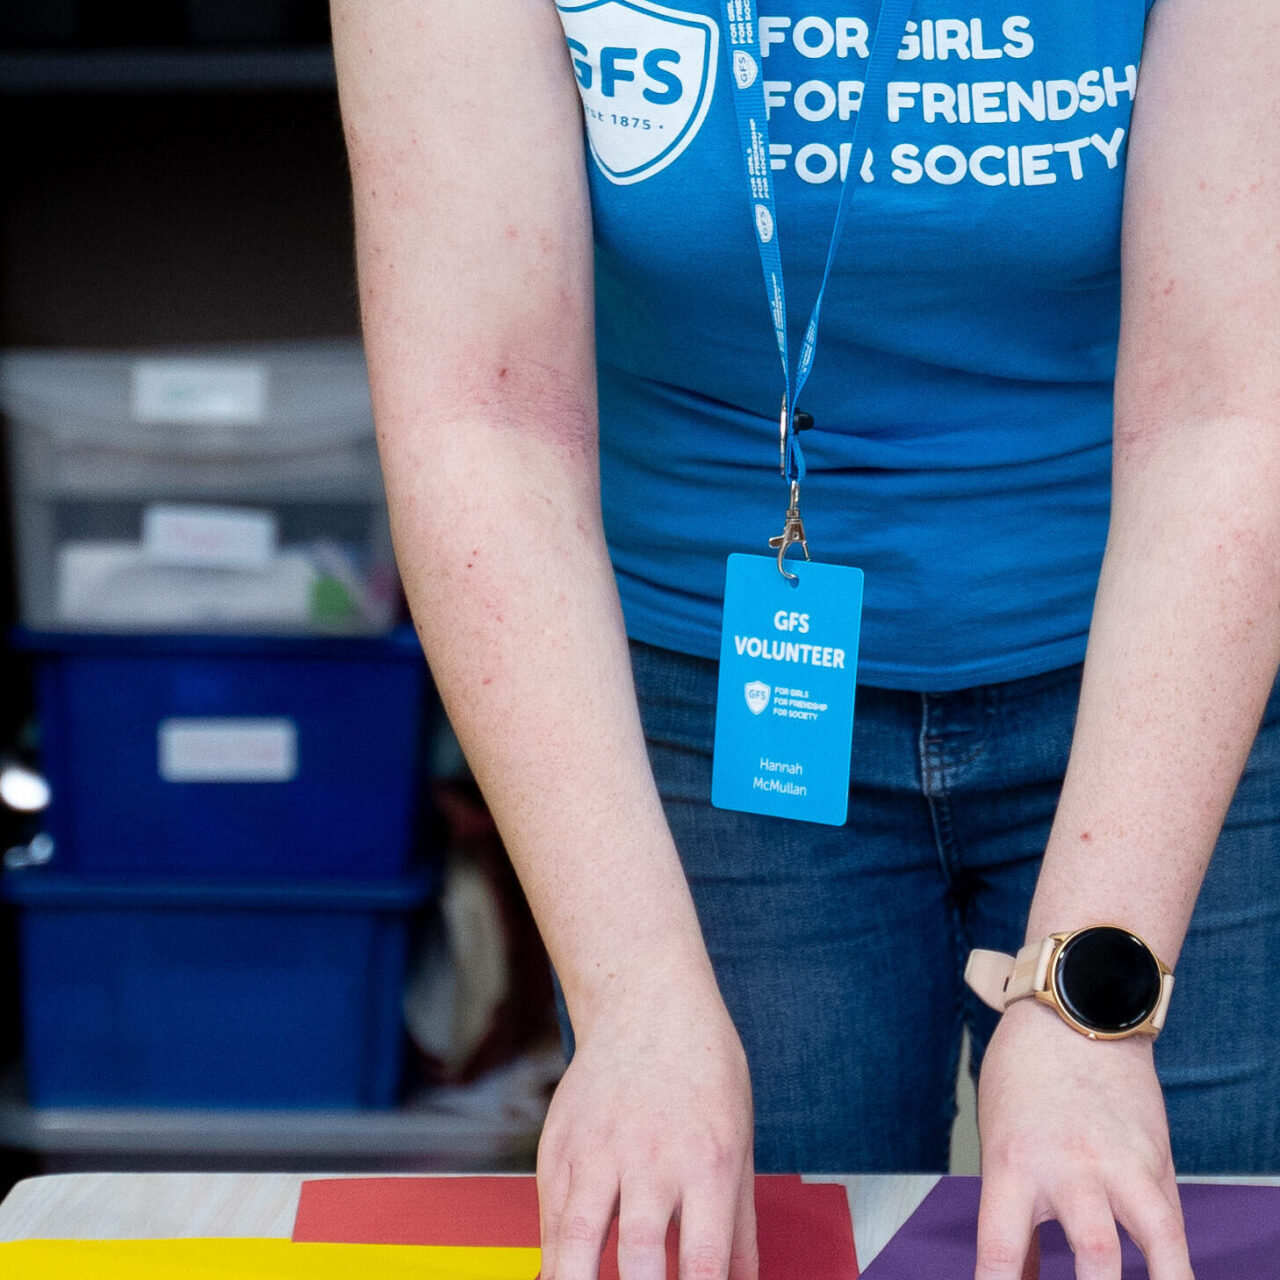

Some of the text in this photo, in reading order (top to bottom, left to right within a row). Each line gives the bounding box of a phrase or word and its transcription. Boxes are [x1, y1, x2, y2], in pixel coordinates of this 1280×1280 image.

[730, 23, 739, 44] FOR
[738, 22, 746, 44] FOR
[746, 22, 754, 44] FOR
[758, 16, 869, 58] FOR
[738, 56, 748, 82] GFS
[887, 65, 1139, 124] FRIENDSH
[611, 114, 651, 130] 1875
[891, 128, 1125, 186] SOCIETY
[774, 610, 810, 634] GFS
[734, 635, 845, 669] VOLUNTEER
[748, 689, 766, 700] GFS
[774, 686, 809, 699] FOR GIRLS
[773, 697, 828, 711] FOR FRIENDSHIP
[773, 707, 818, 720] FOR SOCIETY
[760, 758, 803, 775] Hannah
[753, 777, 807, 796] McMullan
